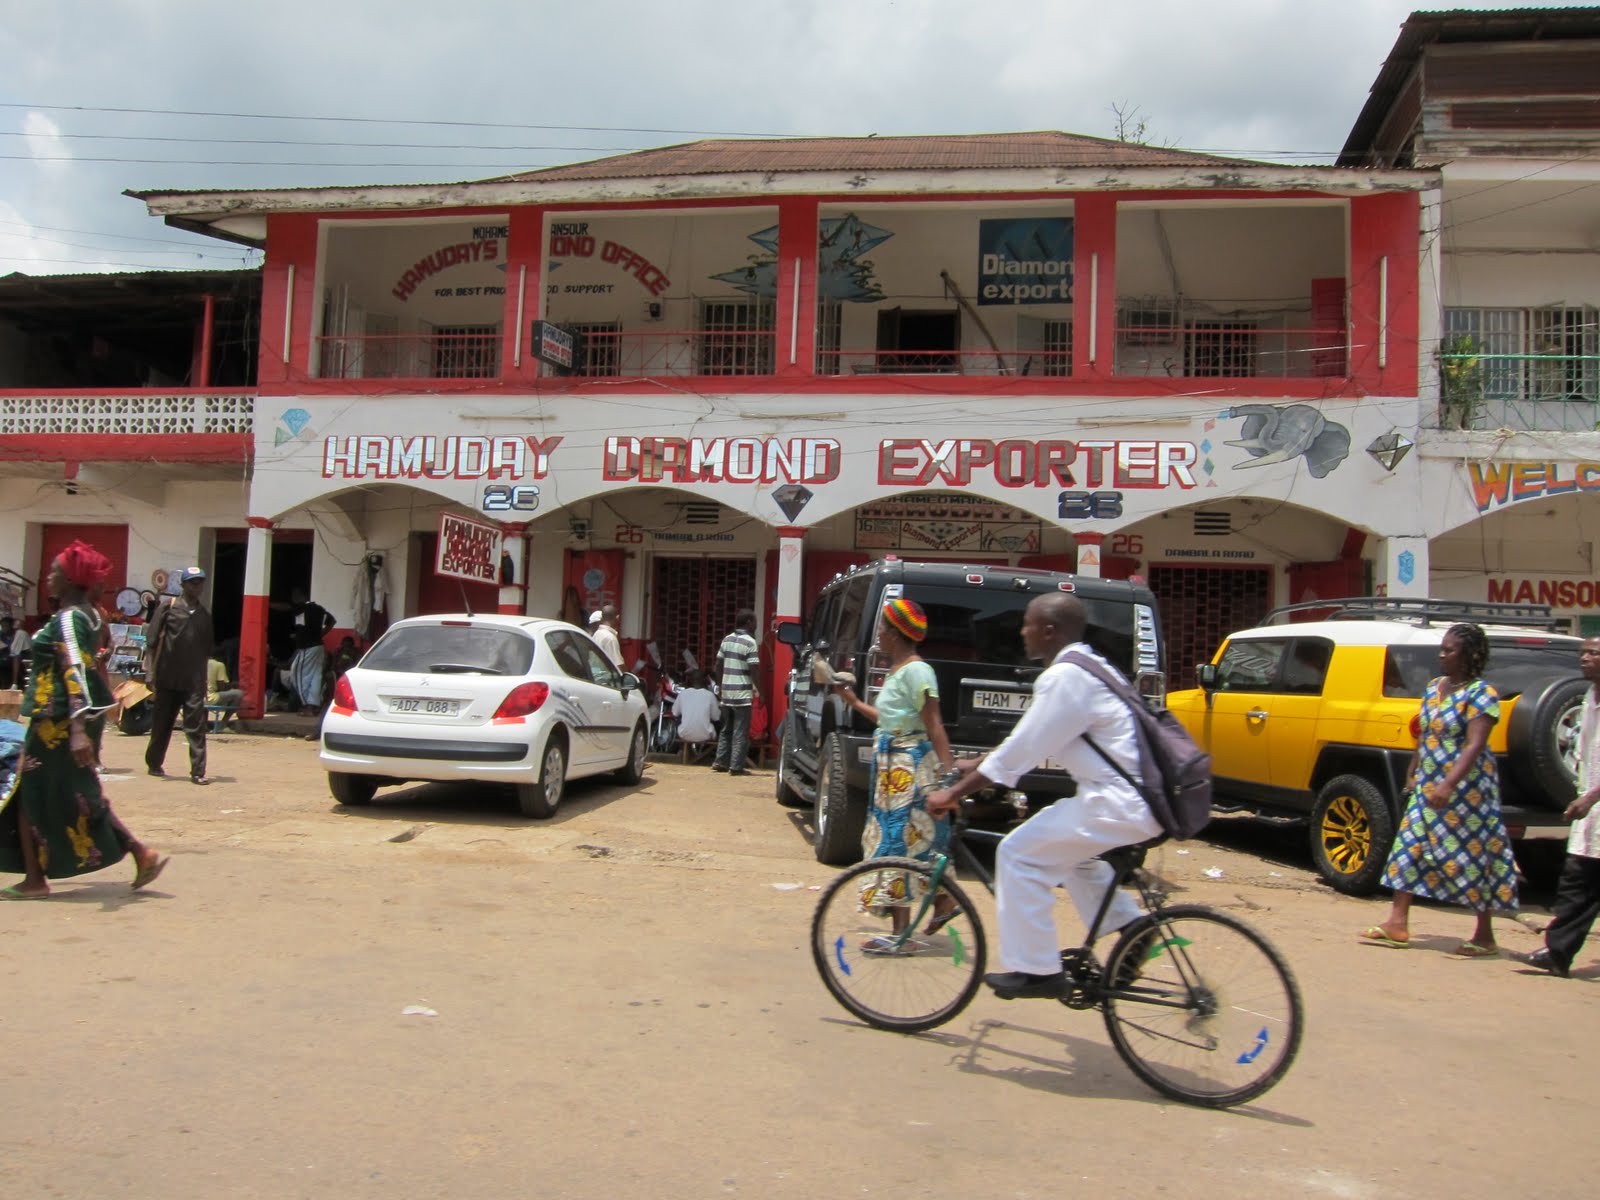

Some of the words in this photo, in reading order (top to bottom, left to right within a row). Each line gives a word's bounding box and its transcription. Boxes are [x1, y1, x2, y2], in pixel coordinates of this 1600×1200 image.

[473, 226, 509, 239] MOHAME
[550, 223, 589, 236] ANSOUR
[601, 240, 671, 297] OFFICE
[983, 254, 1074, 275] Diamon
[435, 288, 453, 297] FOR
[456, 287, 482, 297] BEST
[484, 287, 506, 296] PRIC
[563, 284, 614, 294] SUPPORT
[321, 435, 564, 480] HAMUDAY
[602, 436, 841, 484] DIAMOND
[877, 438, 1197, 489] EXPORTER
[483, 484, 540, 511] 26
[615, 524, 644, 544] 26
[1111, 533, 1144, 555] 26
[442, 553, 496, 581] EXPORTER
[1487, 578, 1600, 609] MANSO
[396, 700, 420, 712] ADZ
[426, 701, 449, 714] 088
[981, 692, 1010, 708] HAM
